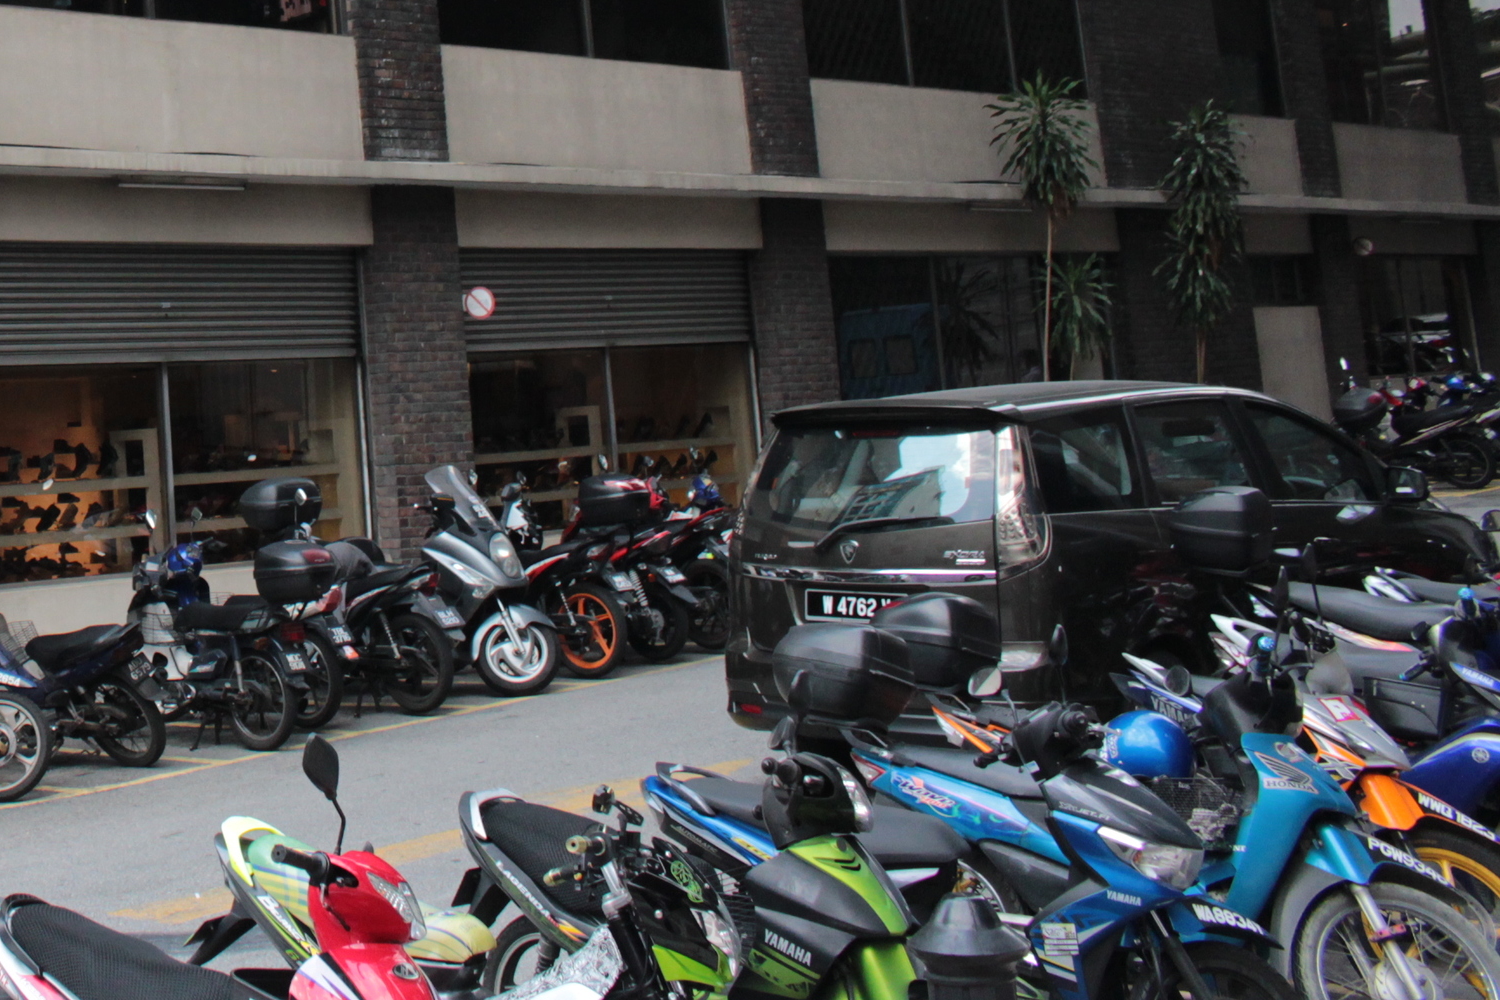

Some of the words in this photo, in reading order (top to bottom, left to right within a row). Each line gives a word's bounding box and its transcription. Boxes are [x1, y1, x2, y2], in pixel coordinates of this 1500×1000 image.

[822, 595, 834, 615] W
[837, 596, 877, 617] 4762
[1266, 780, 1316, 792] HONDA
[1418, 792, 1455, 820] WWQ
[1105, 889, 1142, 906] YAMAHA
[764, 928, 812, 967] YAMAHA
